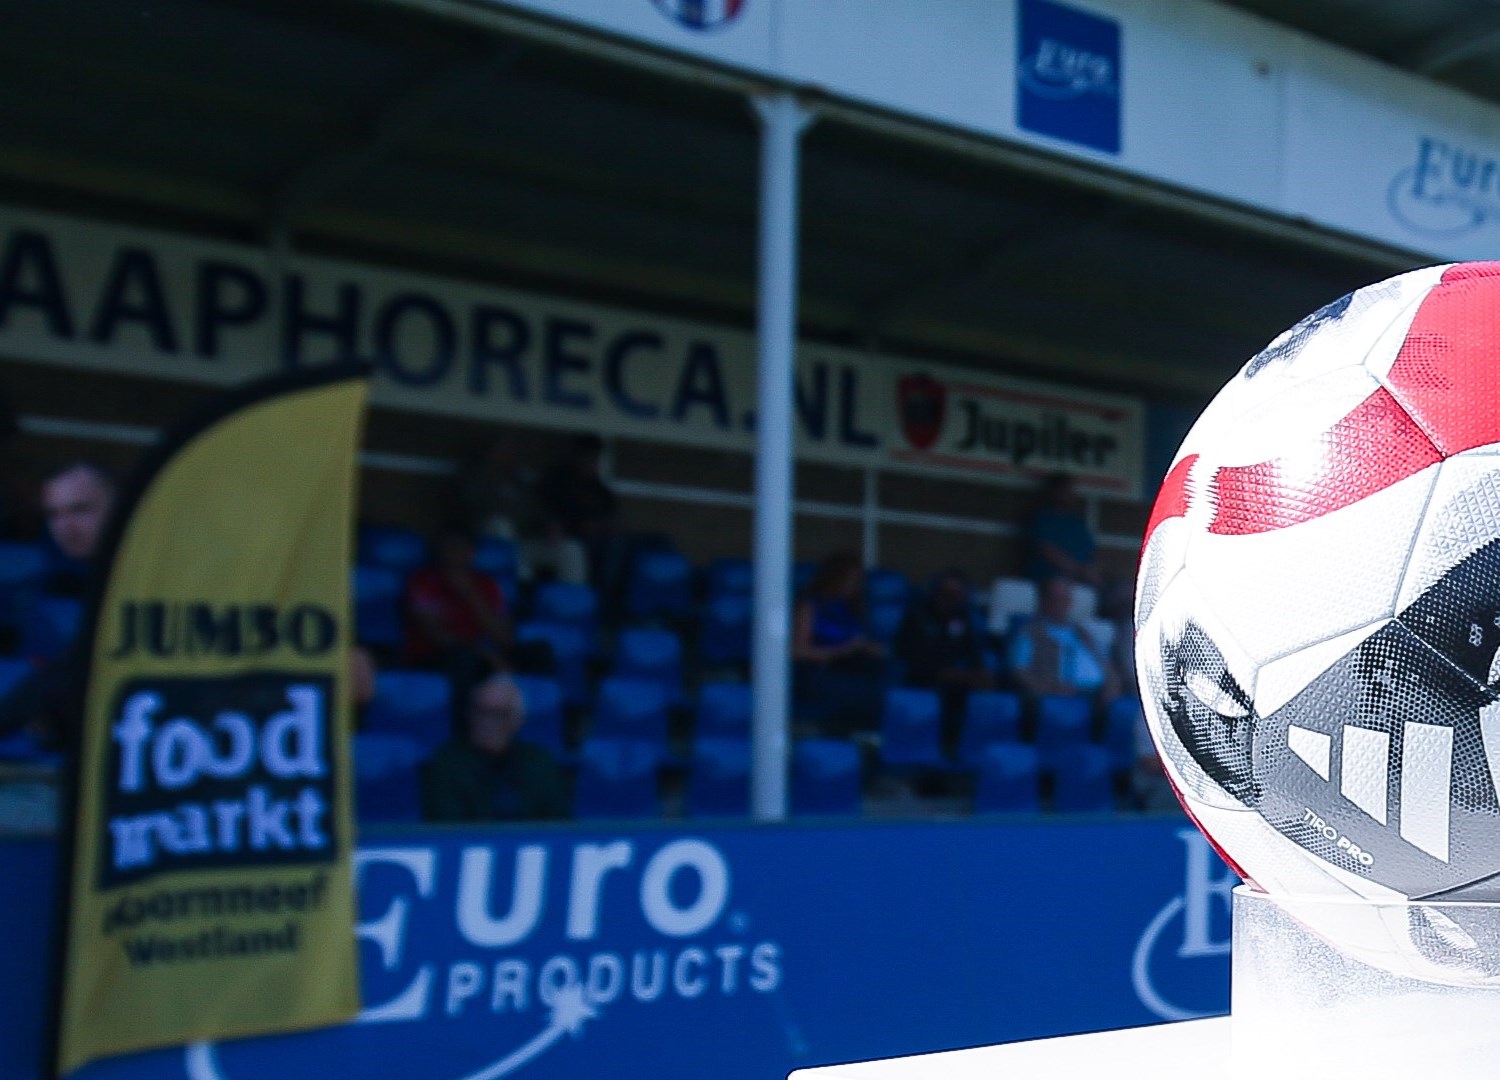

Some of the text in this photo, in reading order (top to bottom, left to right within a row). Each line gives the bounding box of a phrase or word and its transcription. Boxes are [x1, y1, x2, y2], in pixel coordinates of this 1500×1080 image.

[1303, 806, 1375, 866] TIRO PRO
[446, 941, 784, 1018] PRODUCTS
